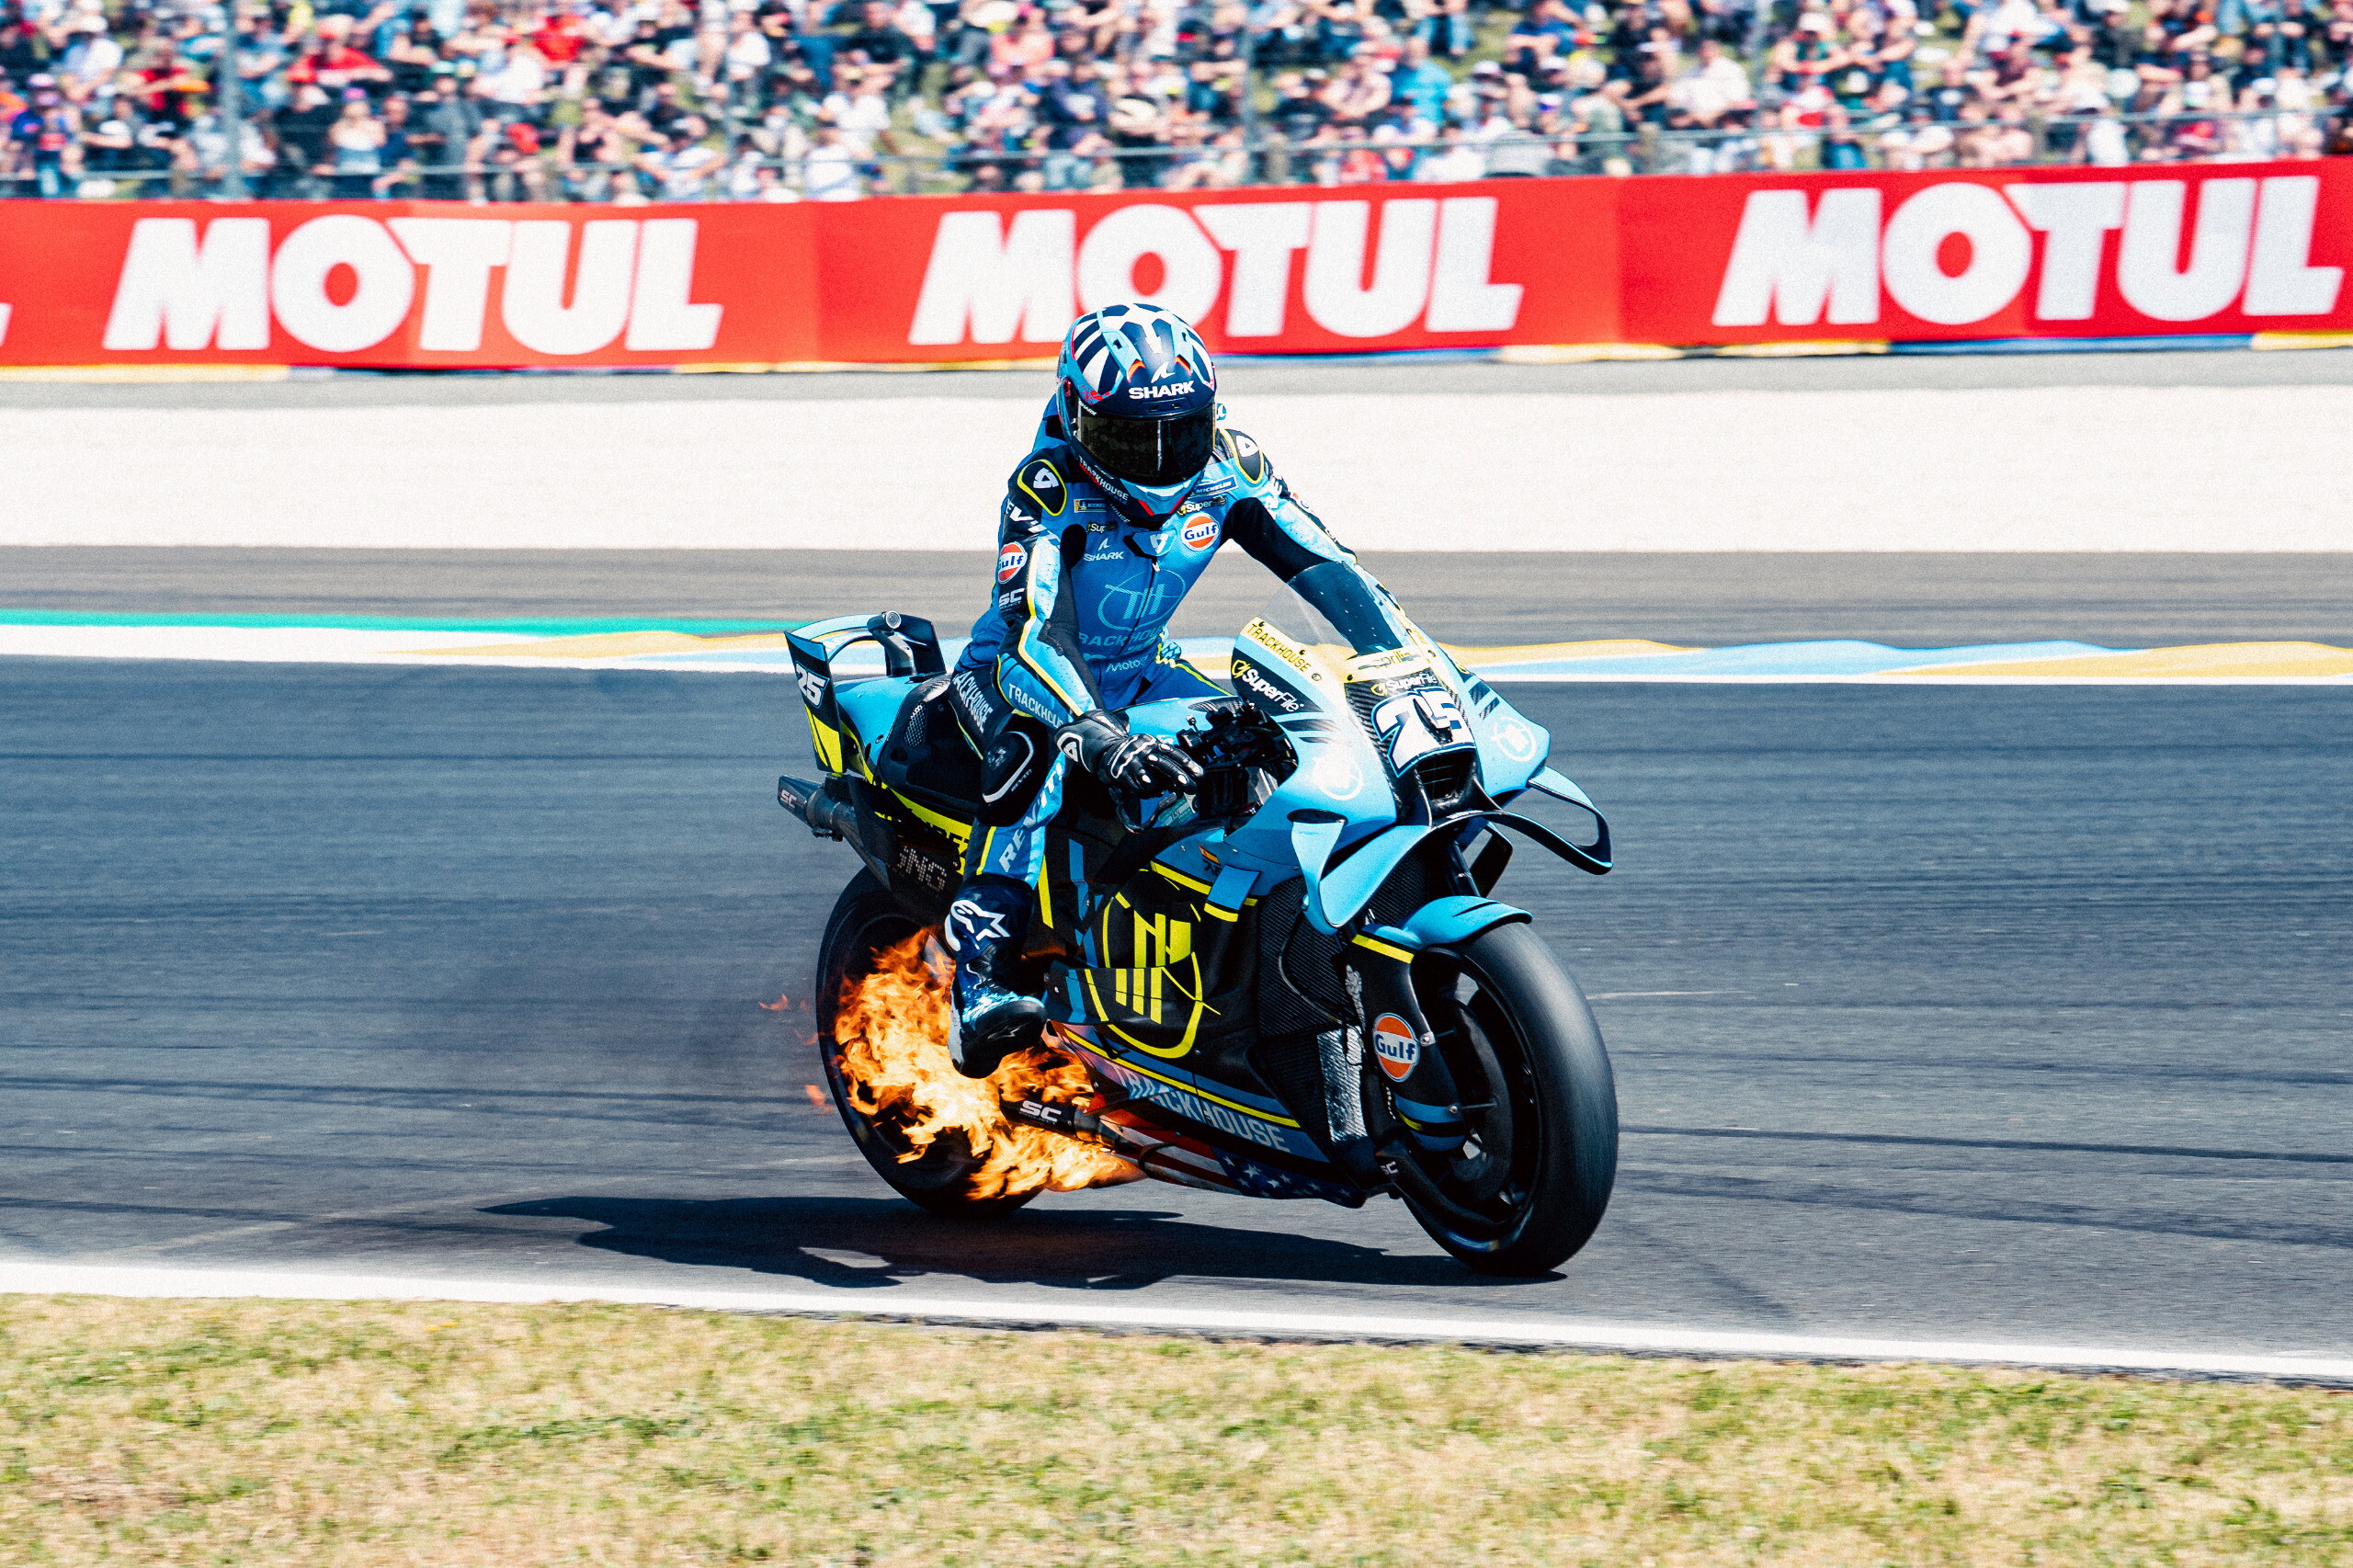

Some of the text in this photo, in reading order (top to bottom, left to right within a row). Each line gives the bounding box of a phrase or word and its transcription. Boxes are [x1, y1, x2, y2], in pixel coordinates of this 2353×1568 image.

[1712, 176, 2344, 327] MOTUL
[103, 214, 723, 355] MOTUL
[908, 197, 1523, 345] MOTUL
[1129, 381, 1195, 399] SHARK
[1184, 524, 1217, 540] Gulf
[1084, 551, 1124, 562] SHARK
[999, 588, 1025, 607] SC
[1246, 623, 1312, 672] TRACKHOUSE
[795, 662, 828, 707] 25
[1242, 669, 1299, 712] SuperFile
[1371, 687, 1476, 778] 25
[780, 790, 797, 809] SC
[1375, 1034, 1415, 1061] Gulf
[1019, 1100, 1063, 1123] SC
